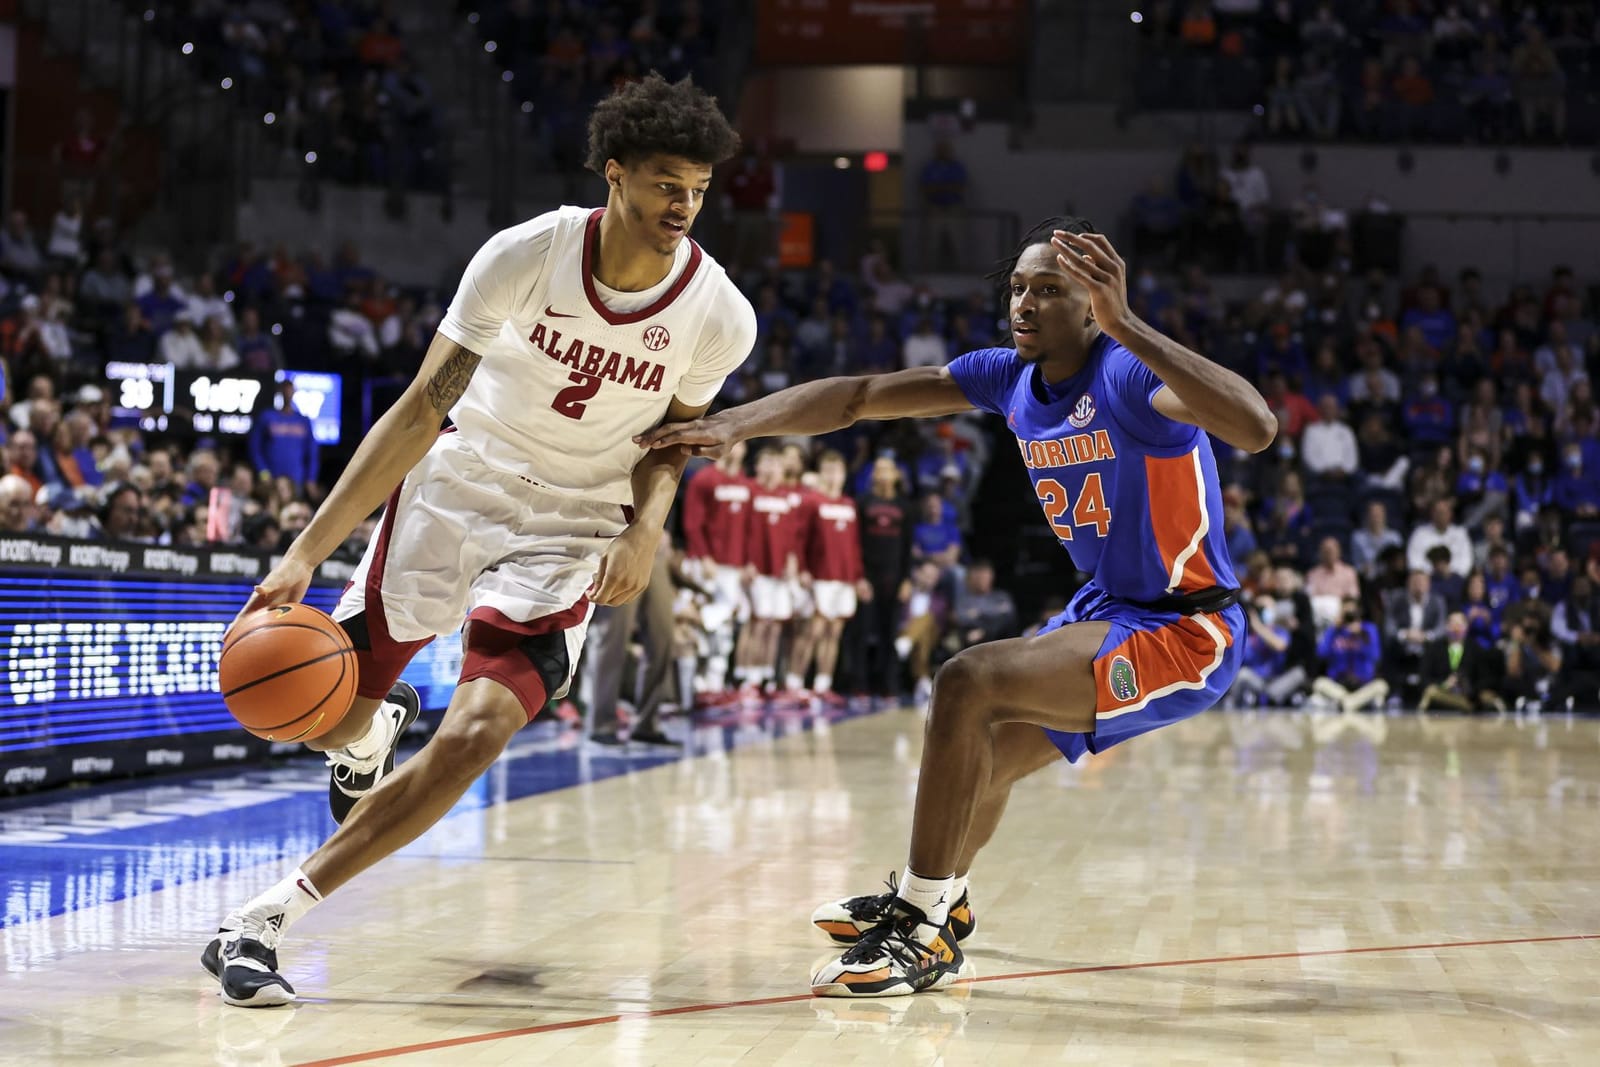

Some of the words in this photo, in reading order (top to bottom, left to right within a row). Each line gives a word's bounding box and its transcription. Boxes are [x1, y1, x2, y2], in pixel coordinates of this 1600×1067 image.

[529, 322, 666, 392] ALABAMA
[643, 326, 670, 350] SEC
[550, 371, 602, 420] 2
[1074, 394, 1093, 419] SEC
[1015, 429, 1116, 469] LORIDA
[1035, 472, 1112, 541] 24
[65, 622, 121, 699] THE
